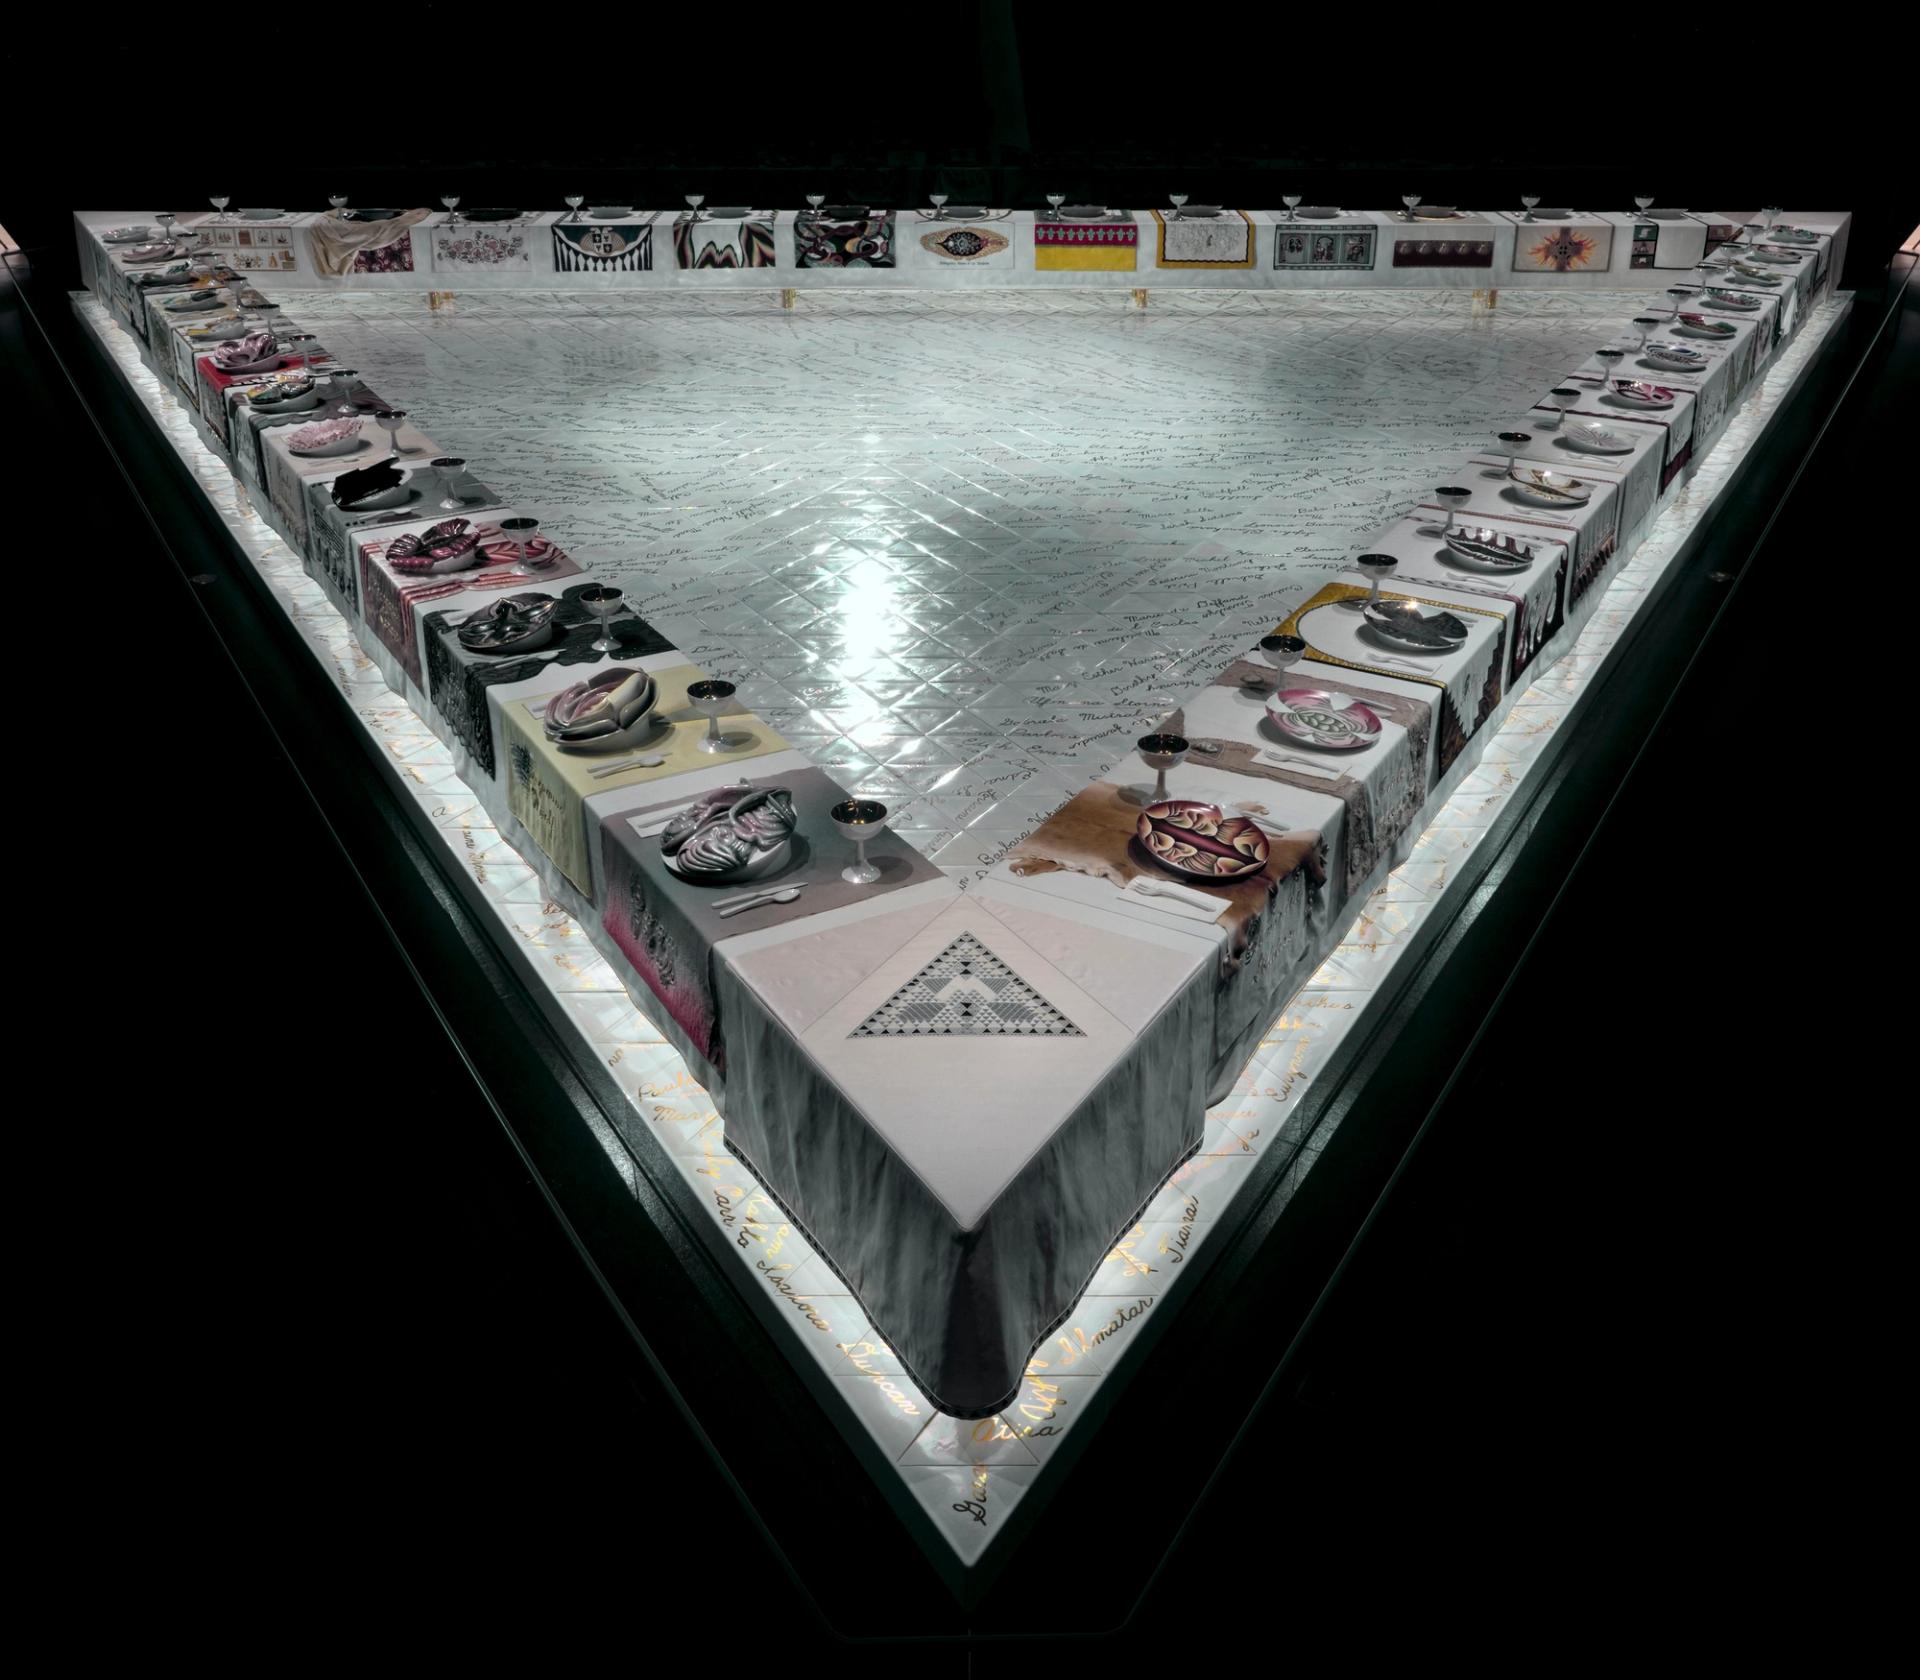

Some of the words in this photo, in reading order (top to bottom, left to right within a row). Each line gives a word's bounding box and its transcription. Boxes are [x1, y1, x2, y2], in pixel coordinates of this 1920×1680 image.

[1078, 708, 1144, 722] Mistral
[977, 830, 1031, 866] Barbara
[1057, 1296, 1154, 1365] Ilmatar
[834, 1341, 921, 1416] Duncan
